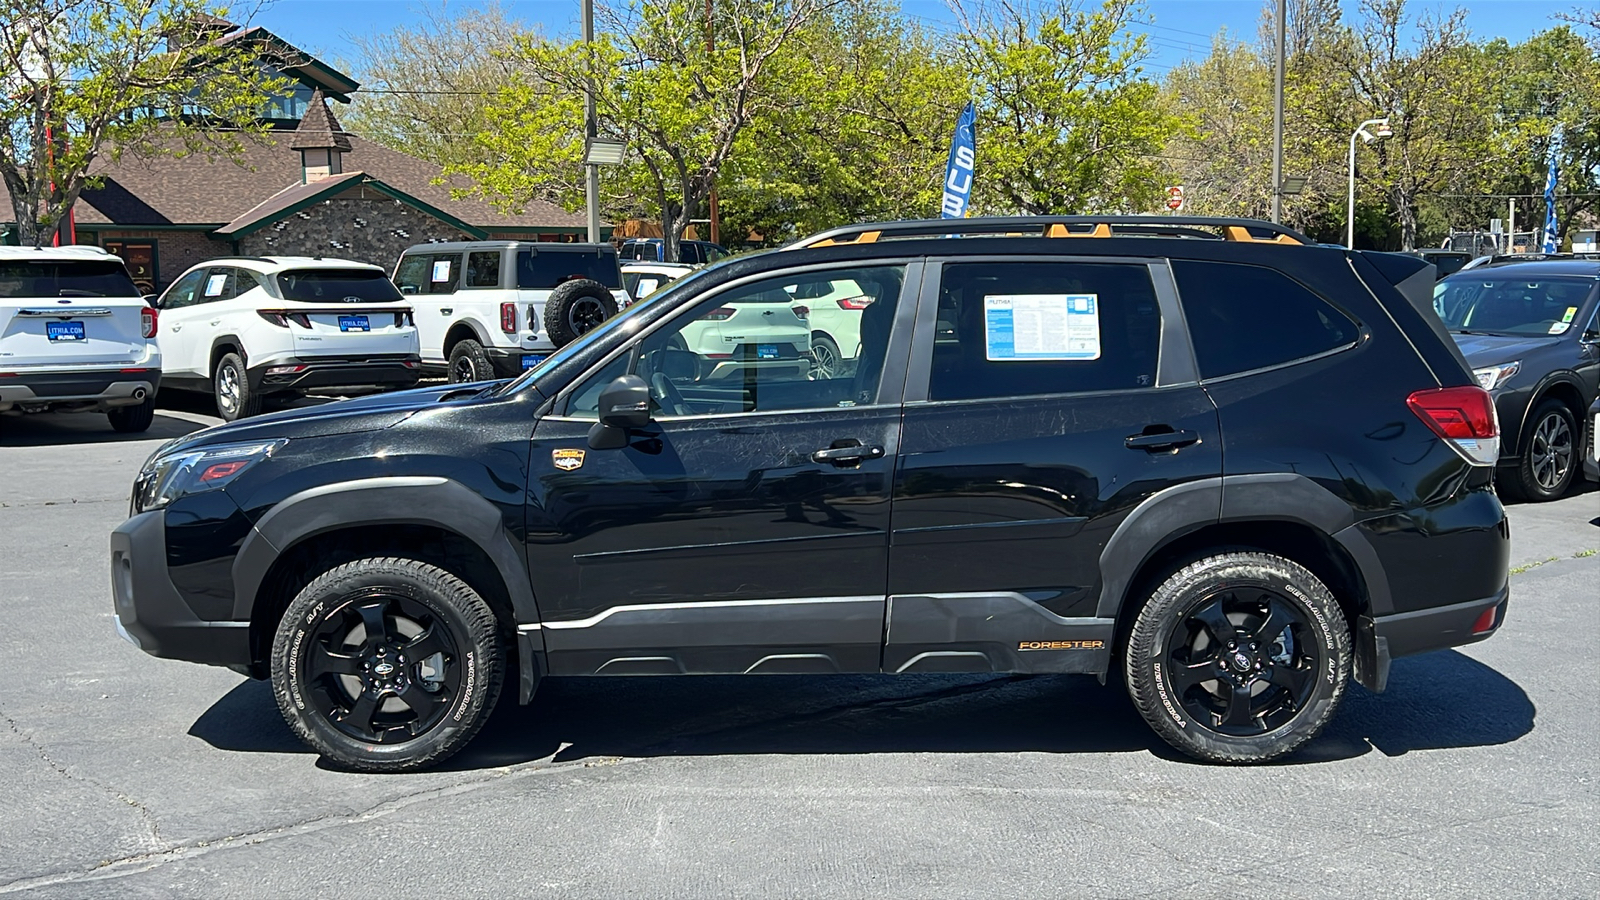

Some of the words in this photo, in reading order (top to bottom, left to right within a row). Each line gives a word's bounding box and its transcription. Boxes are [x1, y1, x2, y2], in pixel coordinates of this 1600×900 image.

[48, 327, 84, 335] LITHIA.COM
[306, 600, 325, 625] A/T
[1019, 640, 1103, 650] FORESTER
[1284, 583, 1335, 650] GEOLANDAR
[287, 628, 305, 711] GEOLANDAR
[452, 651, 476, 723] YOKOHAMA
[1153, 661, 1187, 730] YOKOHAMA
